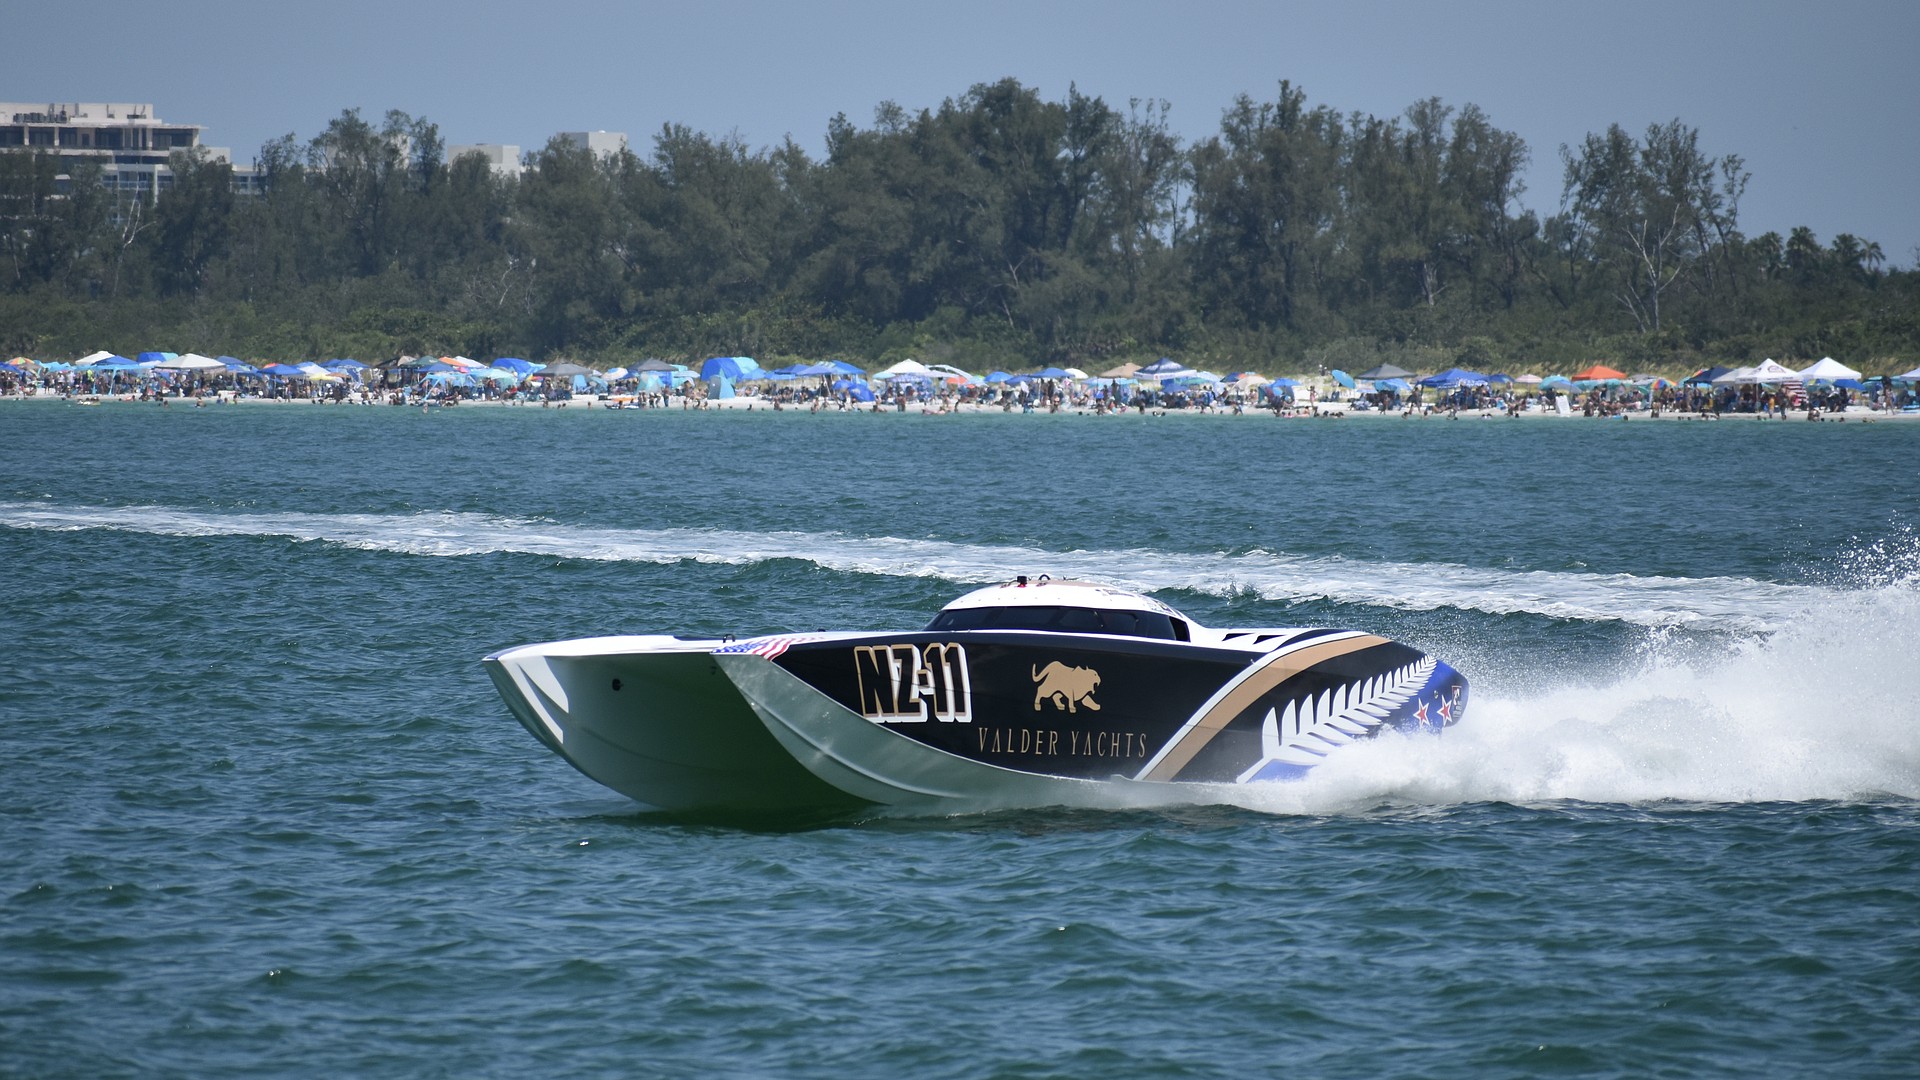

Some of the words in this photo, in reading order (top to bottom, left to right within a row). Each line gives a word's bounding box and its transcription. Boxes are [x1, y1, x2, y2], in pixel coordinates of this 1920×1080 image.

[854, 642, 972, 723] NZ-11
[978, 727, 1059, 756] VALDER
[1071, 731, 1147, 758] YACHTS
